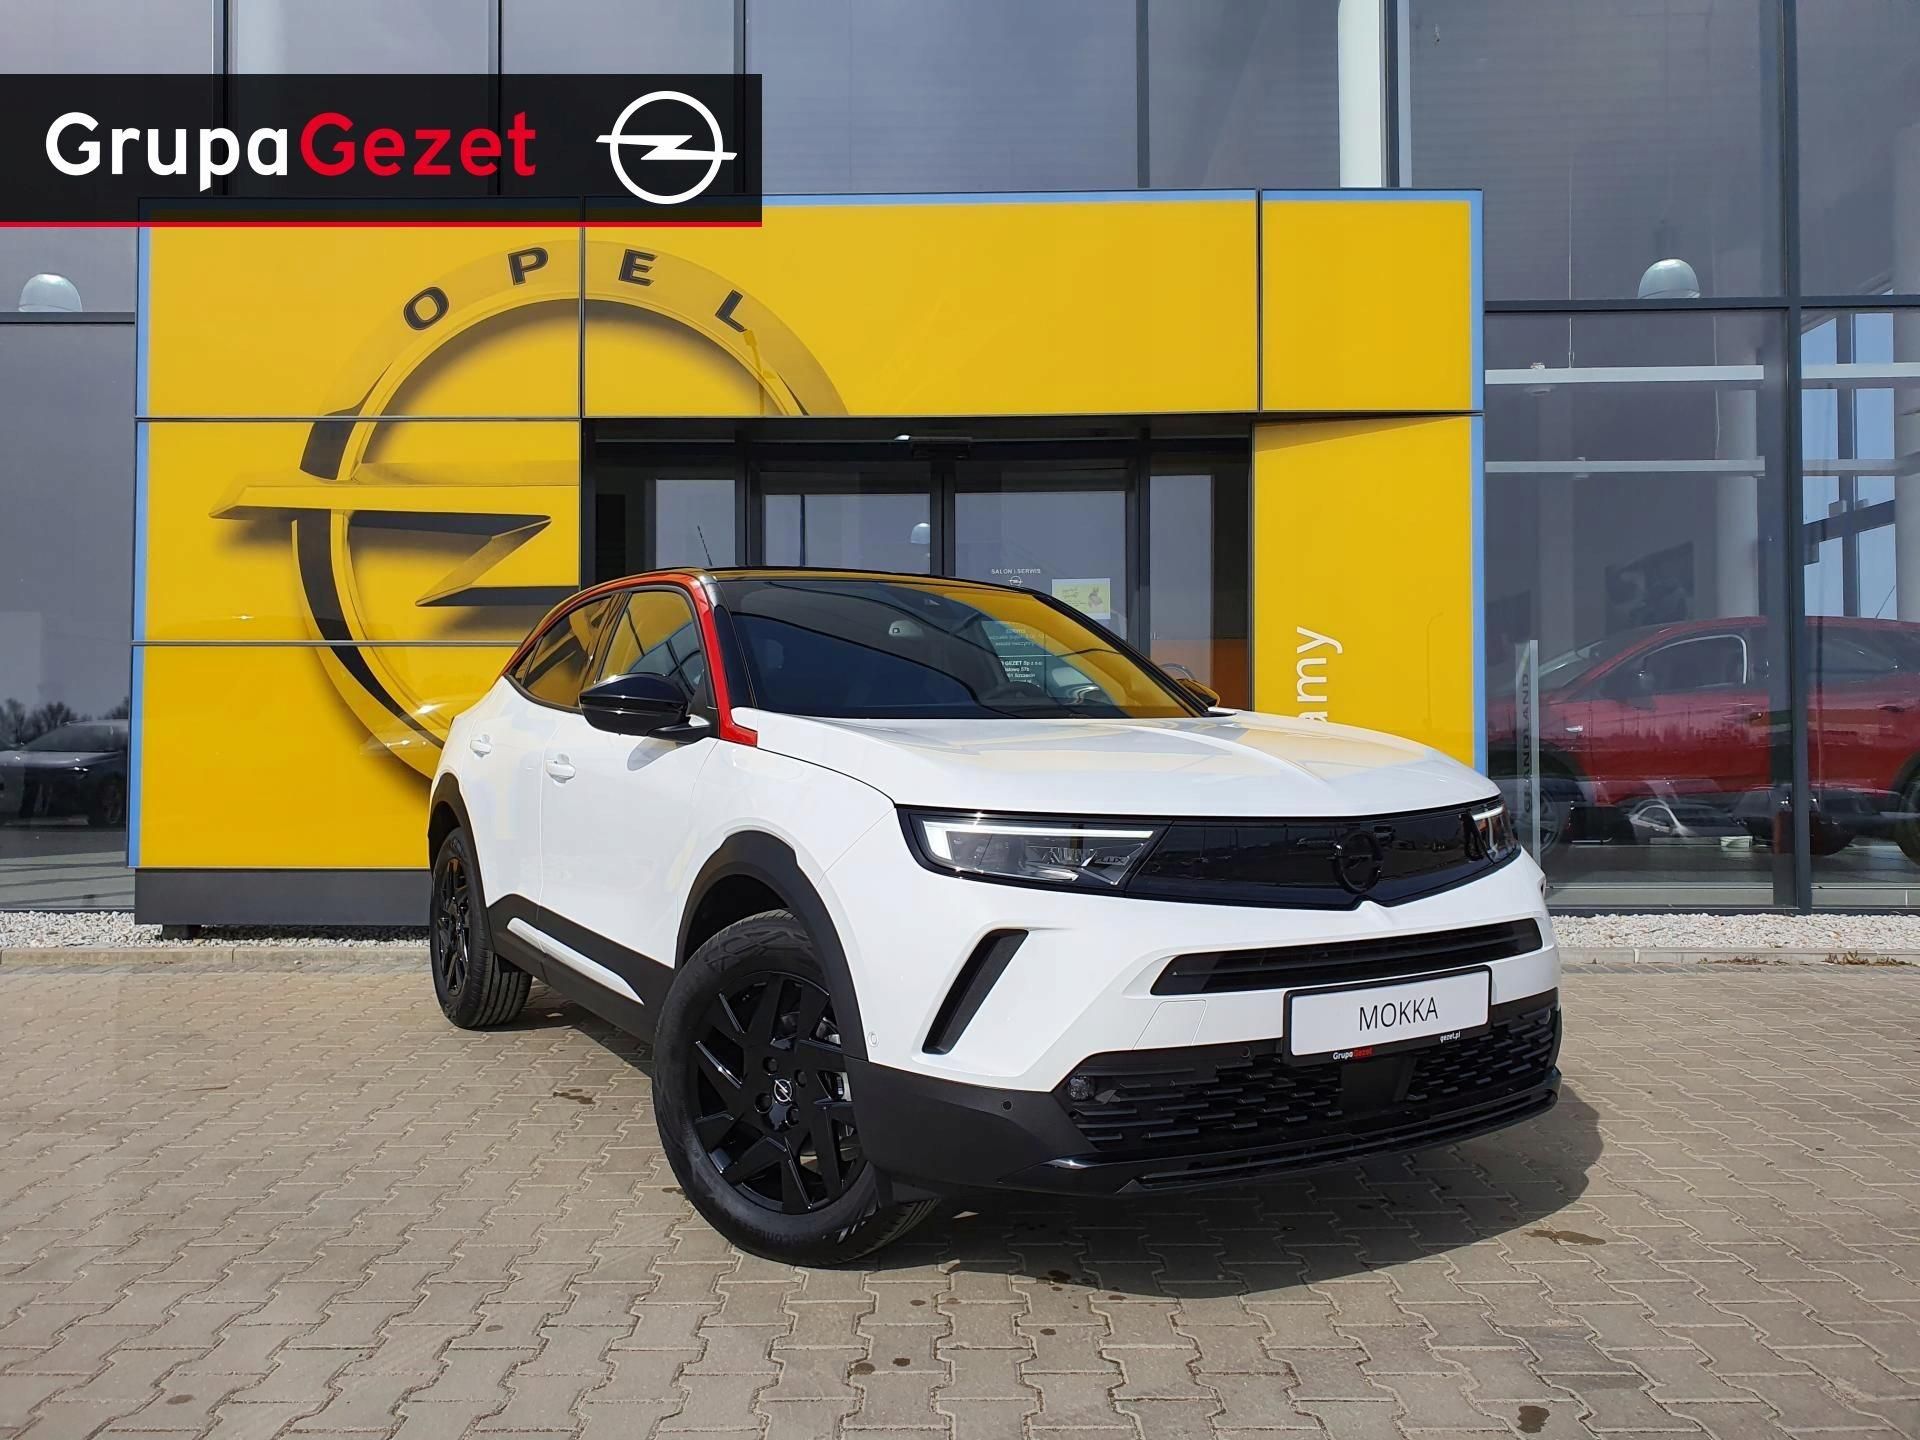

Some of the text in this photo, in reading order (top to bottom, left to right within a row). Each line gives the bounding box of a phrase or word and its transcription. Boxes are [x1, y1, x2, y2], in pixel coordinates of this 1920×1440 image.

[403, 246, 747, 332] OPEL
[1520, 672, 1531, 813] GRANDLAND
[1359, 996, 1438, 1031] MOKKA
[1439, 1031, 1461, 1043] gezet.pl
